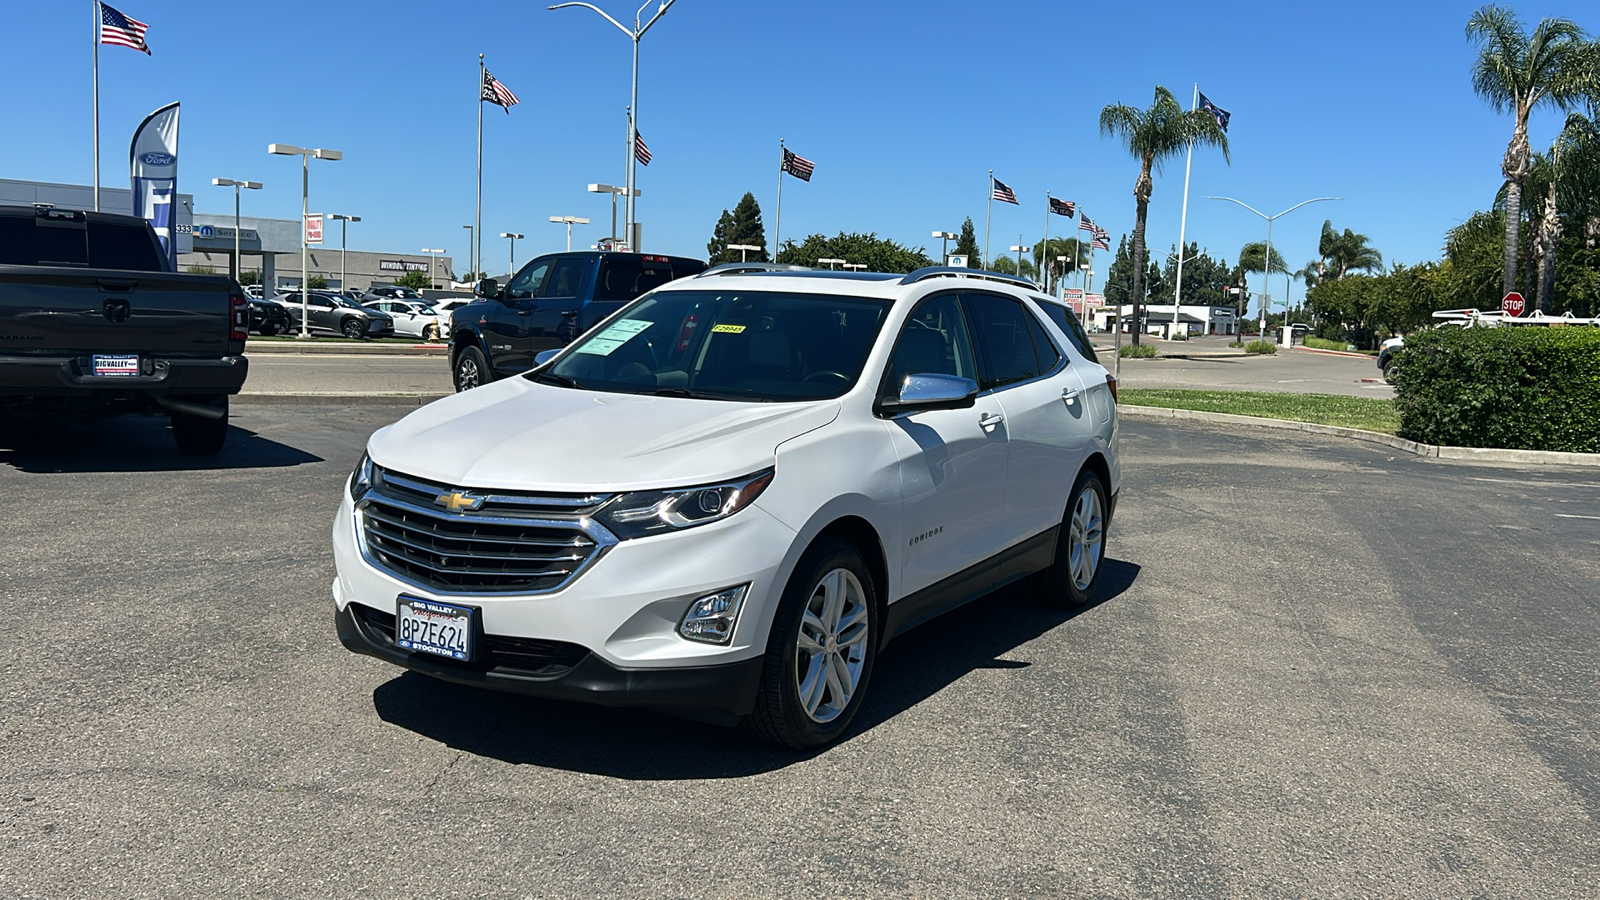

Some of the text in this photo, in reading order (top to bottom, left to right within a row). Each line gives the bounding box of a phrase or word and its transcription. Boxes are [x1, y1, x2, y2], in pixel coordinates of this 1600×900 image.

[146, 153, 172, 164] Ford
[217, 229, 252, 237] Servce
[1503, 300, 1523, 310] STOP
[427, 603, 453, 614] VALLEY
[402, 617, 465, 652] 8PZE624
[412, 643, 453, 656] STOCKTON
